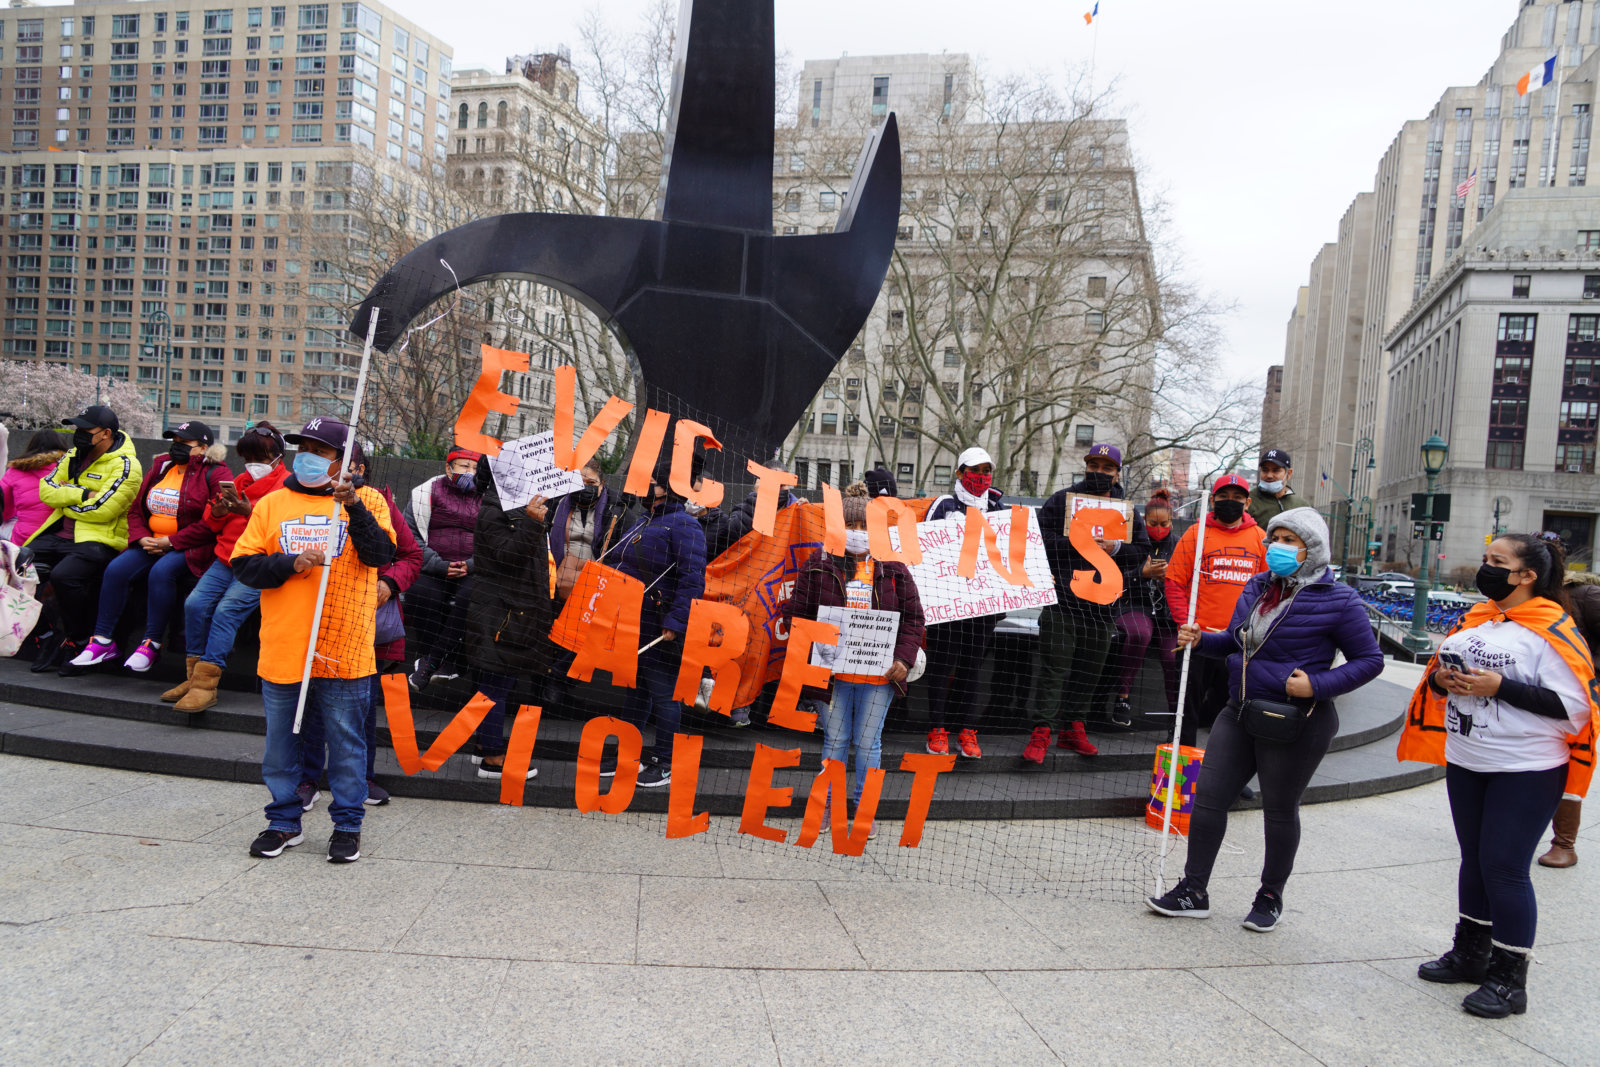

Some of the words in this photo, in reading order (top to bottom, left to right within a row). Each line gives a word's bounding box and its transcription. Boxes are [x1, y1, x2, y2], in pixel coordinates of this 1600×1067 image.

[519, 440, 543, 450] CUOMO
[521, 448, 547, 459] PEOPLE
[453, 343, 1126, 605] EVICTIONS
[291, 527, 313, 536] NEW
[314, 528, 330, 536] YOR
[290, 541, 329, 552] CHANG
[1213, 558, 1232, 566] NEW
[1234, 559, 1253, 568] YORK
[1212, 570, 1252, 582] CHANGE
[965, 575, 991, 592] FOR
[846, 601, 869, 609] ANGE
[953, 596, 1001, 618] EQUALITY
[1003, 591, 1022, 611] AND
[1021, 587, 1058, 606] RESPECT
[849, 622, 874, 630] PEOPLE
[1465, 636, 1486, 649] FUND
[566, 573, 841, 733] ARE
[1467, 644, 1511, 660] EXCLUDED
[1474, 657, 1517, 668] WORKERS
[380, 673, 957, 857] VIOLENT
